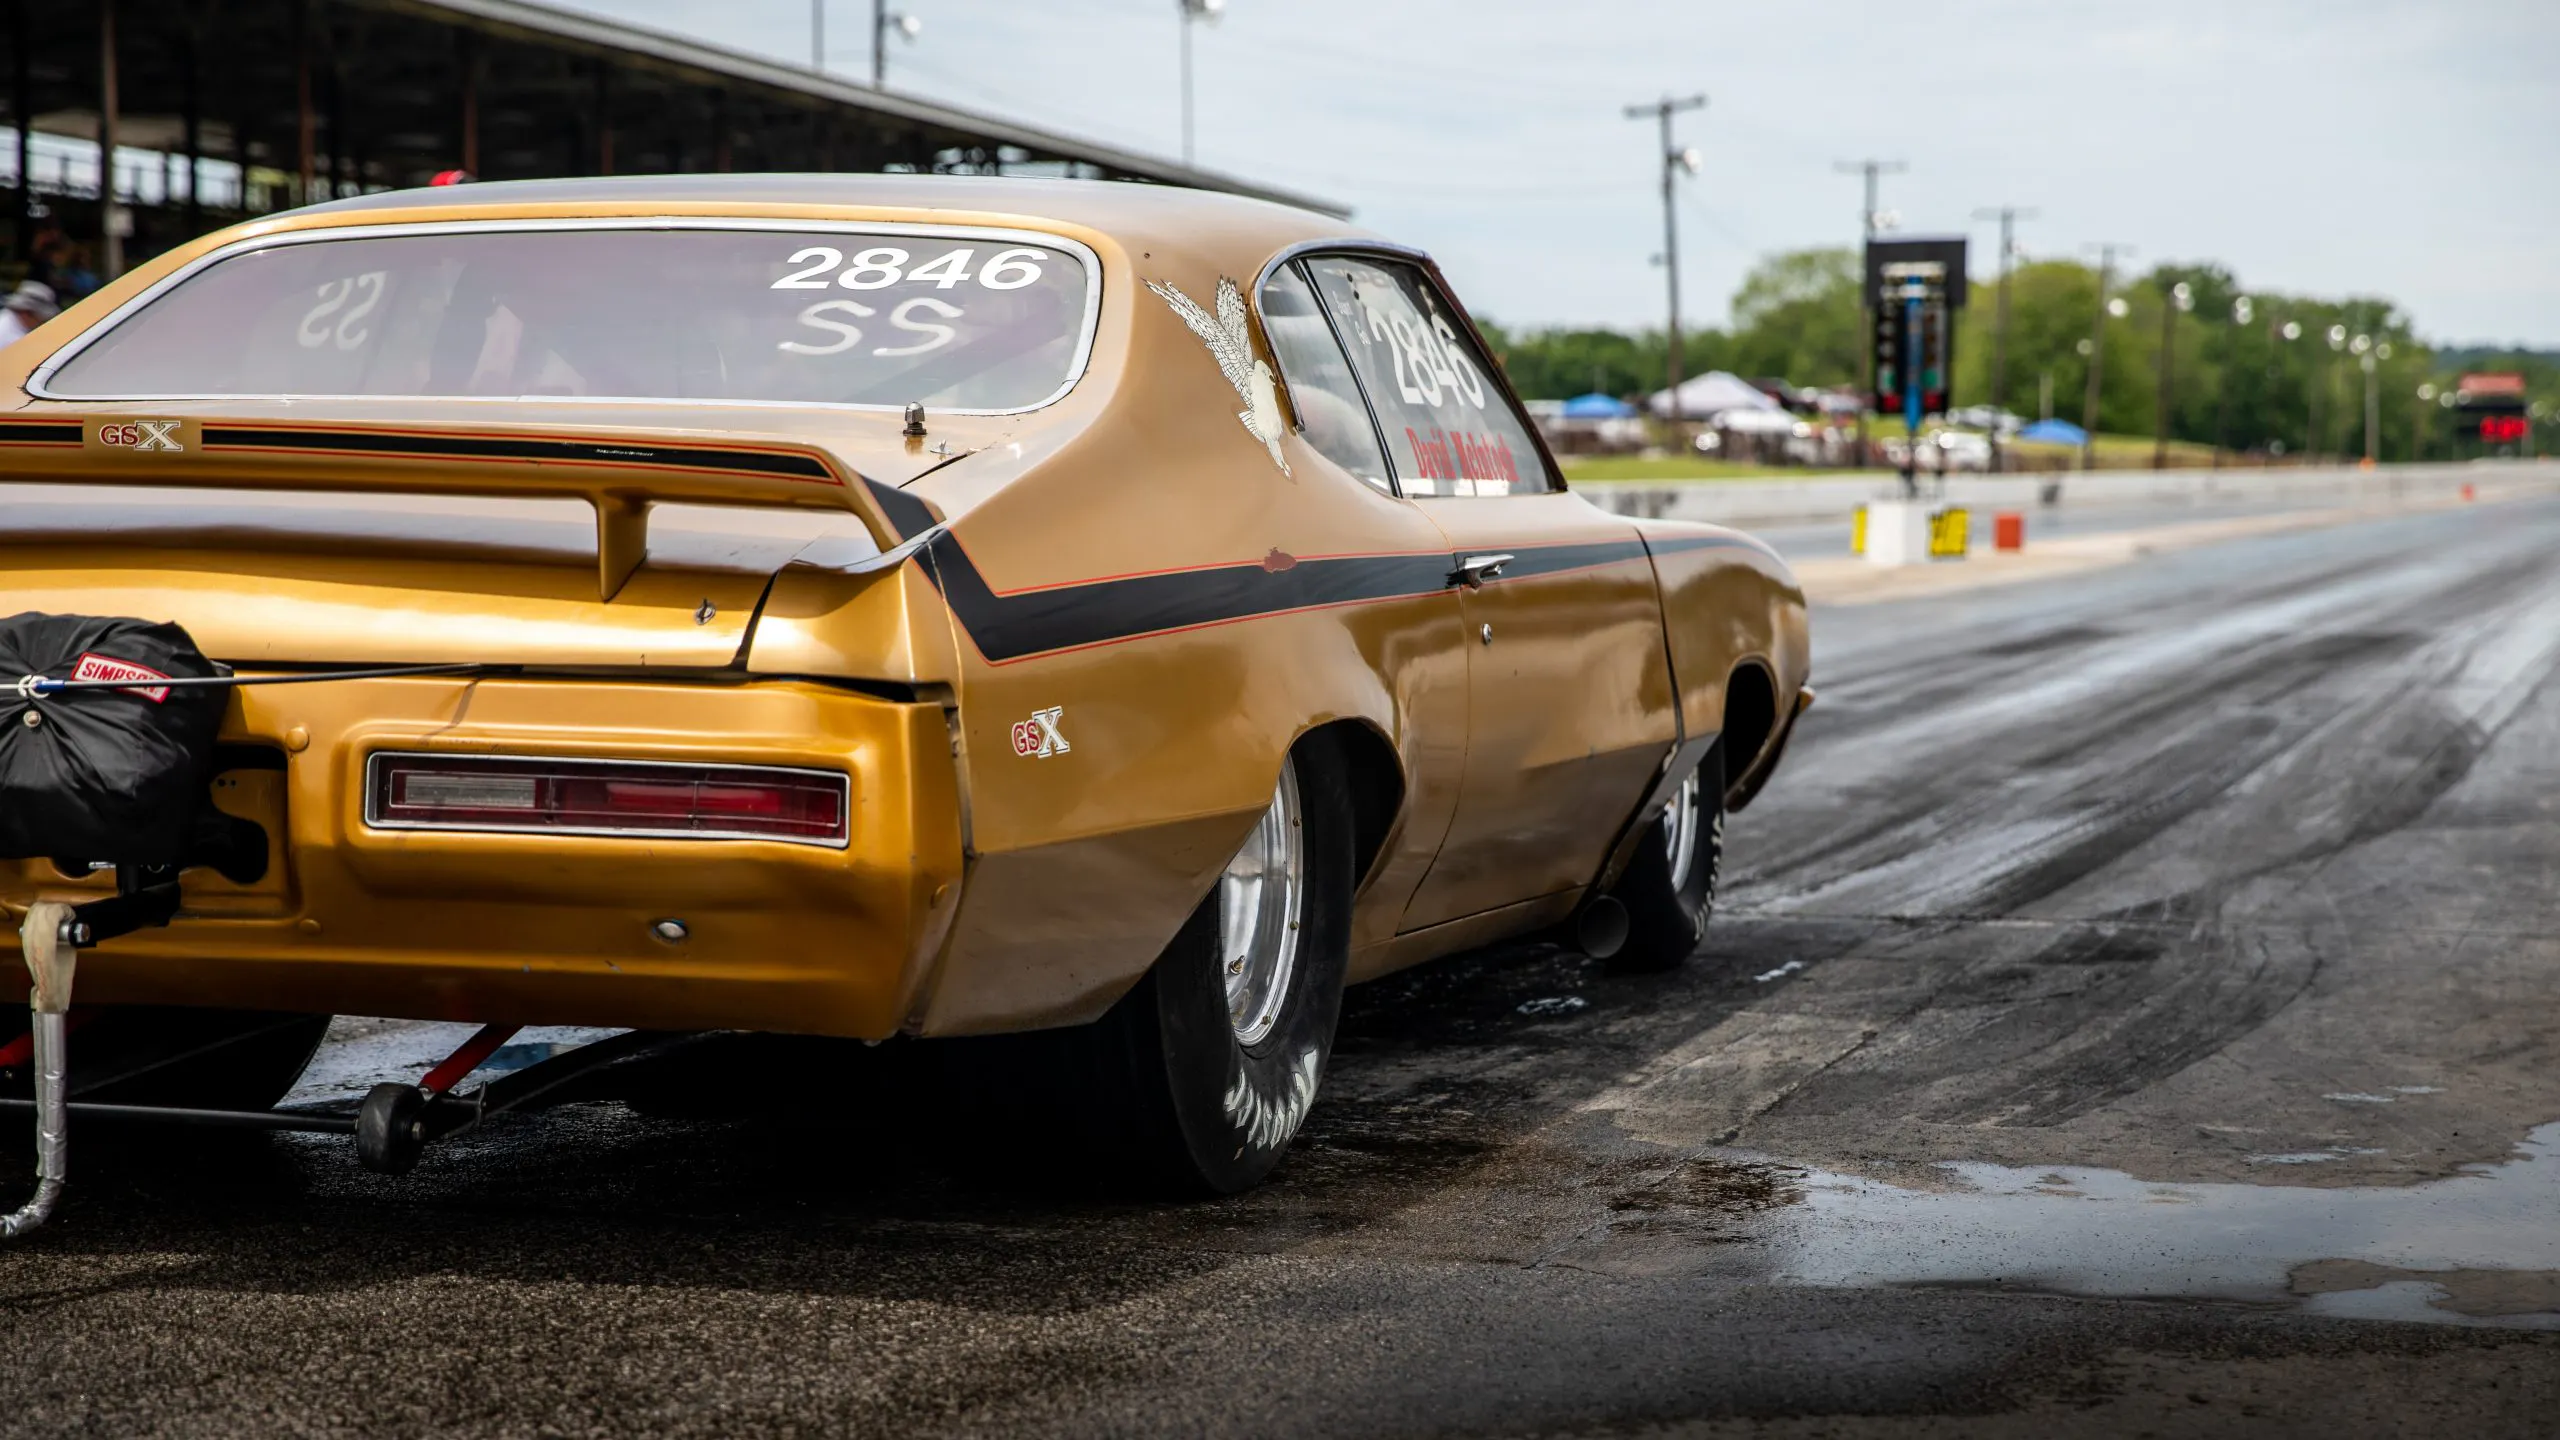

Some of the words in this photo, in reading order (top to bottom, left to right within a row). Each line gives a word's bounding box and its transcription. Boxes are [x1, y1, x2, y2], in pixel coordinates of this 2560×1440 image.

[770, 246, 1048, 290] 2846
[778, 297, 964, 356] SS
[1366, 306, 1485, 410] 2846
[100, 420, 183, 452] GSX
[1405, 426, 1456, 480] David
[1450, 431, 1519, 482] McIntosh
[1011, 705, 1070, 758] GSX
